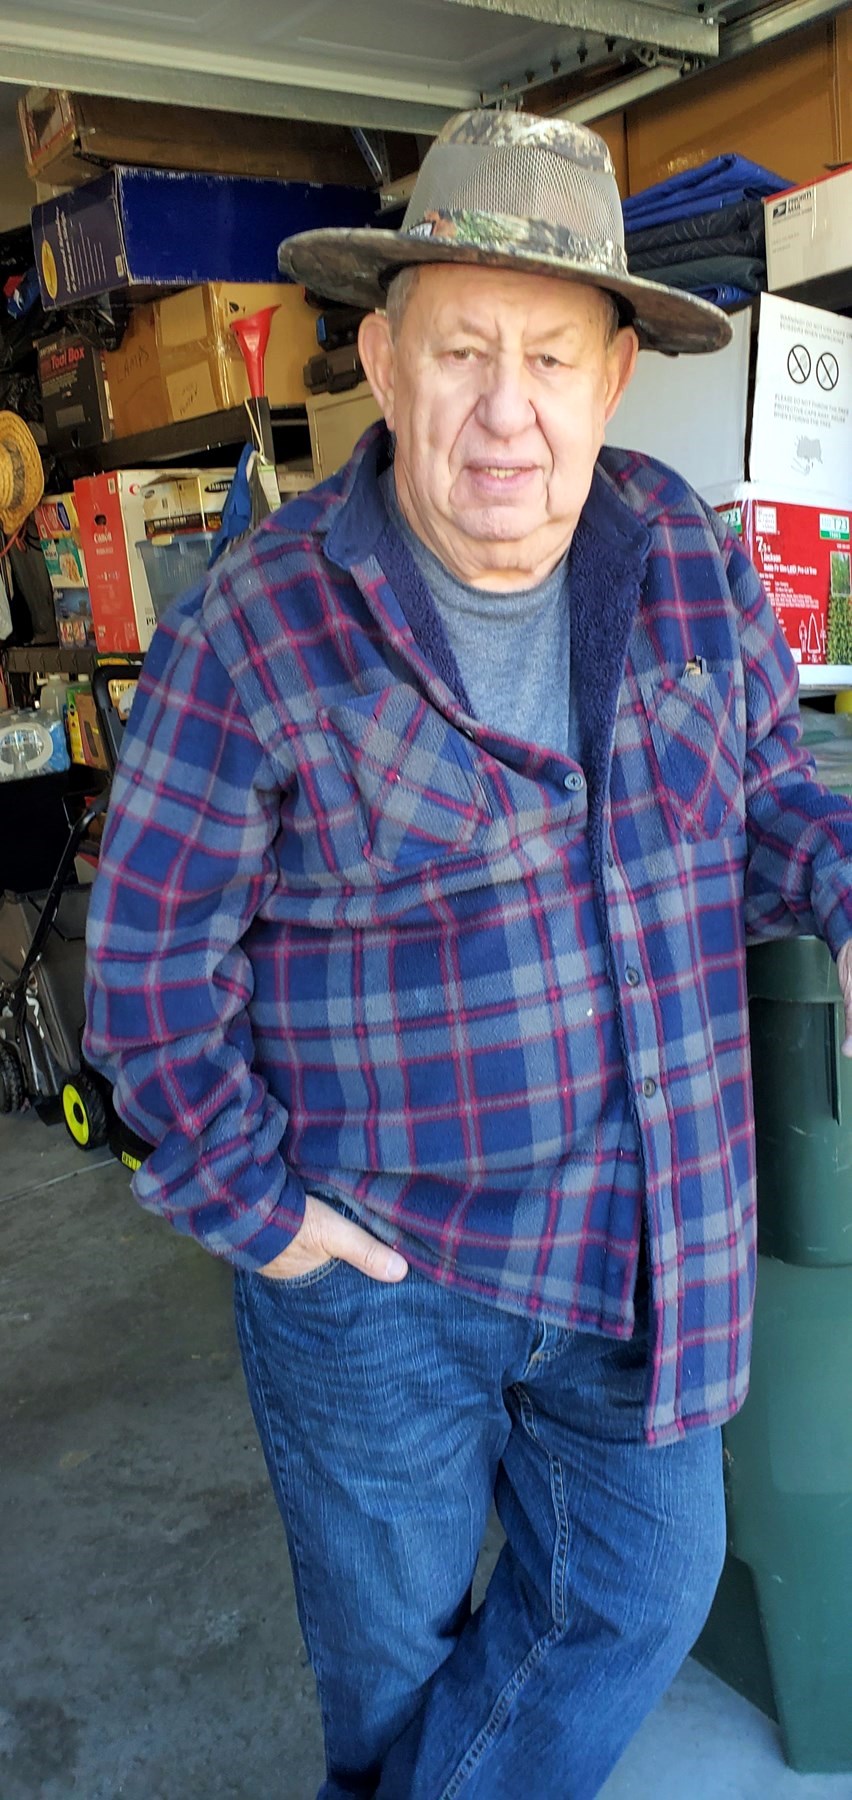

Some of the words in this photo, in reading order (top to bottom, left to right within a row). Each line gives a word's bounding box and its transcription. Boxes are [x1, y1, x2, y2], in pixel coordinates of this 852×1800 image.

[51, 350, 67, 369] Tool
[68, 346, 85, 363] Box
[774, 393, 793, 403] PLEASE
[774, 402, 803, 415] PROTECTIVE
[773, 411, 788, 420] WHEN
[93, 531, 113, 544] Canon
